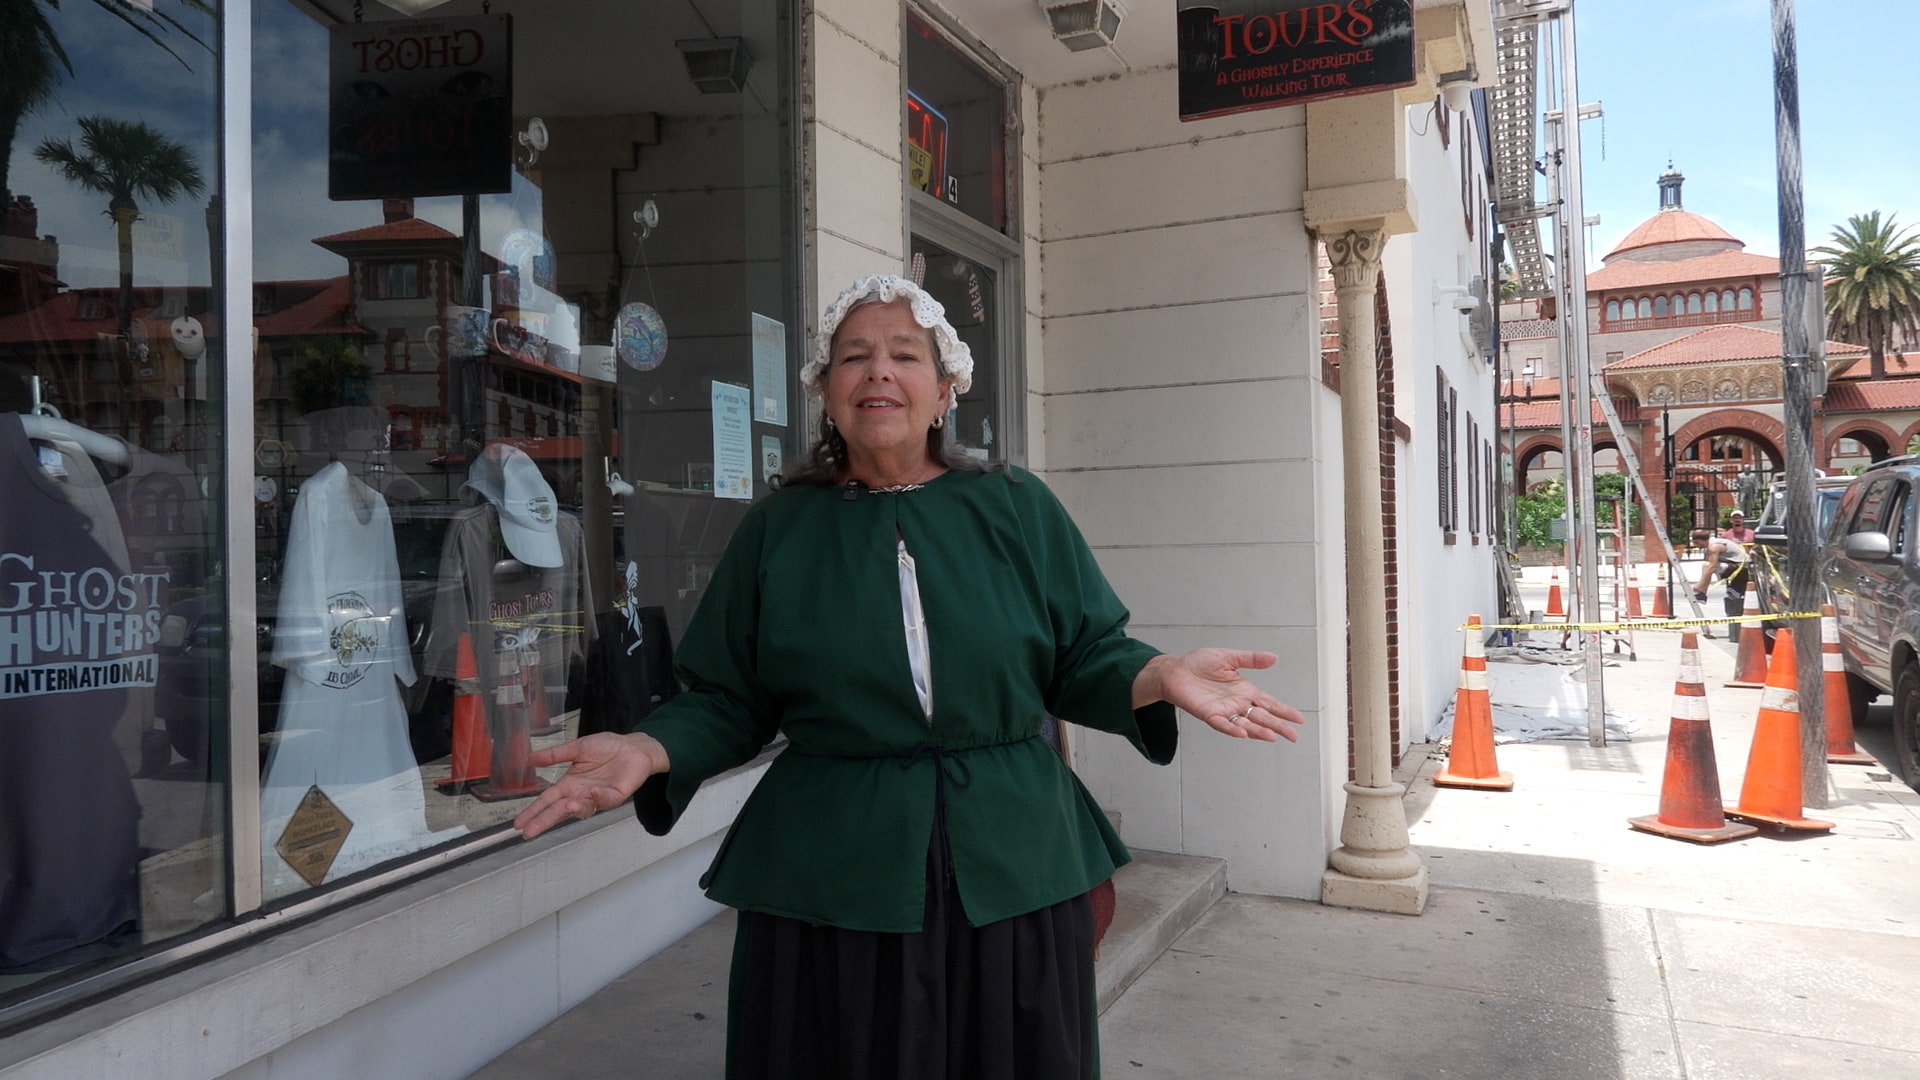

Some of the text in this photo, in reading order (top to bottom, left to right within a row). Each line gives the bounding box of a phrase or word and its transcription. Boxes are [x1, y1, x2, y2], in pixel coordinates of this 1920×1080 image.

[1212, 0, 1374, 60] TOURS
[1216, 49, 1374, 86] A GHOSTLY EXPERIENCE
[1242, 72, 1350, 99] WALKING TOUR
[949, 178, 957, 202] 4
[0, 553, 170, 612] GHOST
[489, 590, 554, 620] GHOST TOURS
[0, 607, 161, 666] HUNTERS
[4, 658, 155, 694] INTERNATIONAL
